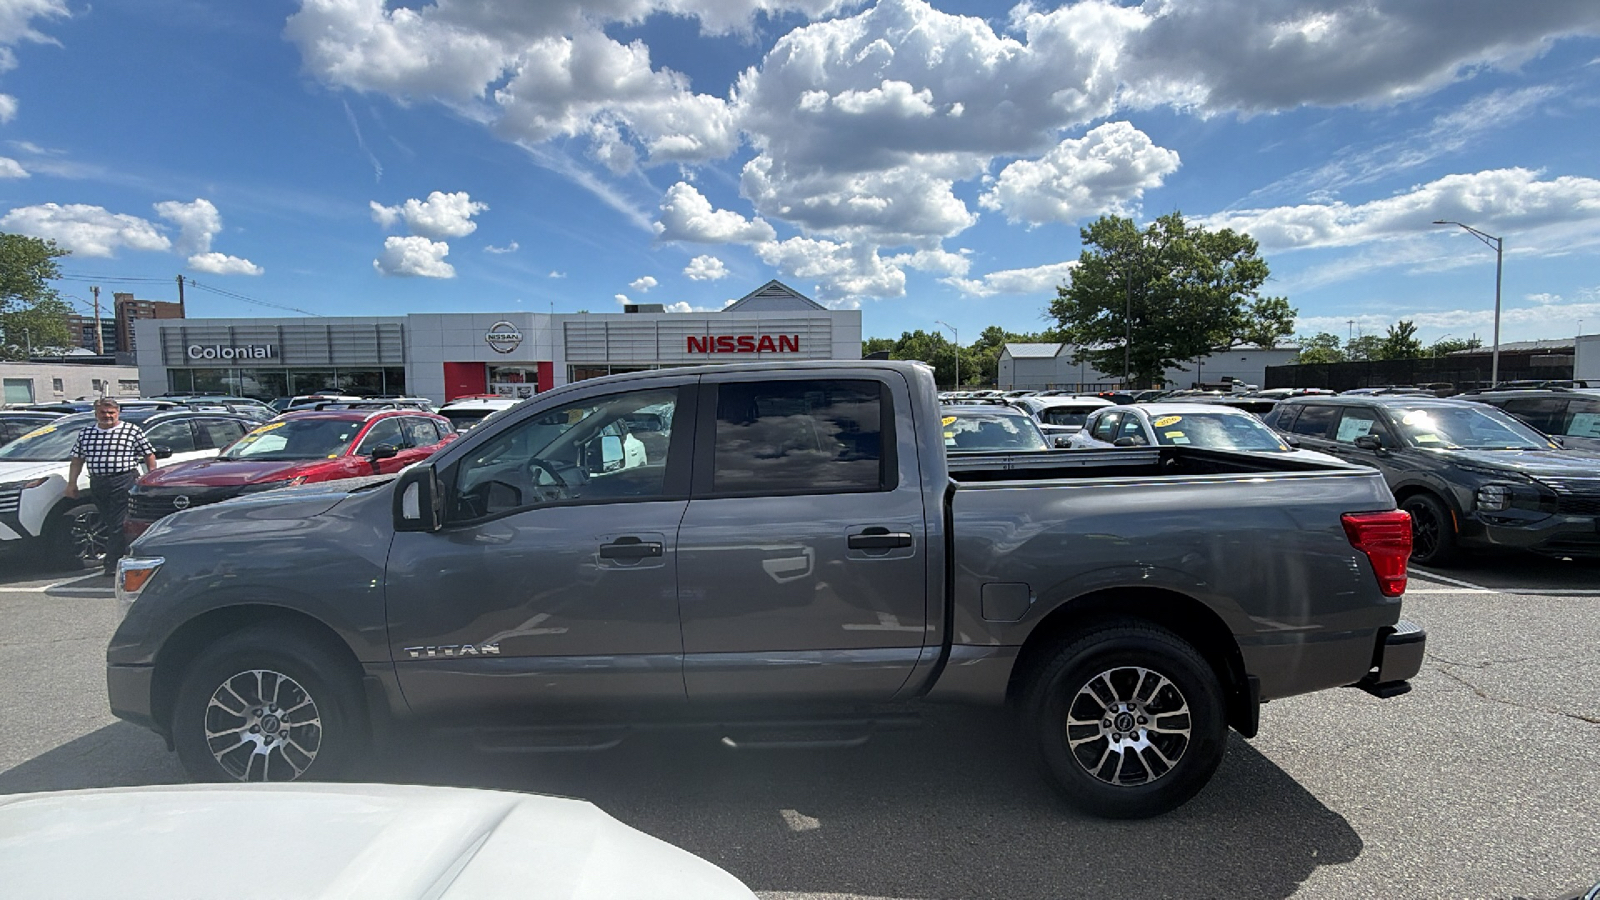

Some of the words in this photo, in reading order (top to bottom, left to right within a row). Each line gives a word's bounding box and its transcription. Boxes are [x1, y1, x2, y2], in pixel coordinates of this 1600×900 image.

[687, 334, 799, 353] NISSAN
[187, 344, 272, 359] Colonial
[403, 643, 500, 658] TITAN
